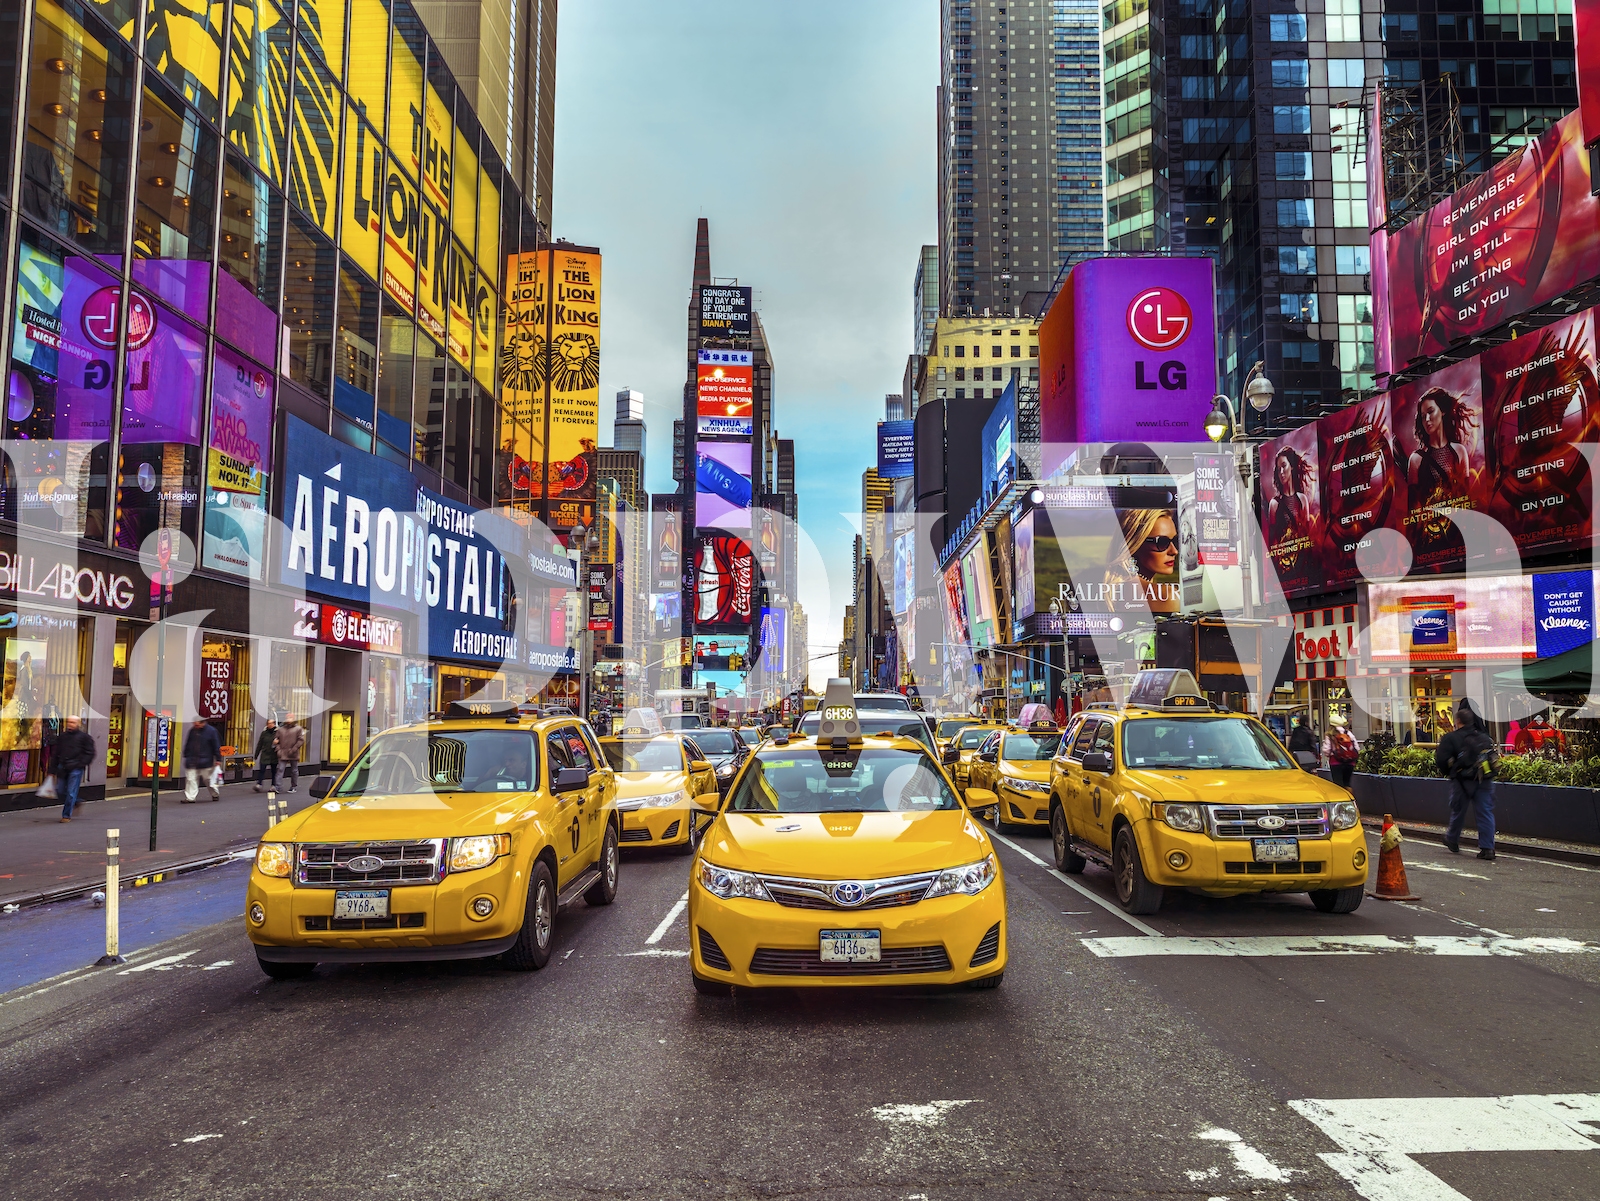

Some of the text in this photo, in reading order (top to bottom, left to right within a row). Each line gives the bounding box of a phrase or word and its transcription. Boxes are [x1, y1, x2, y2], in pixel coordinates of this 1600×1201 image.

[410, 101, 450, 200] THE
[354, 97, 430, 271] LION
[1442, 172, 1516, 228] REMEMBER
[1436, 193, 1526, 257] GIRL ON FIRE
[1451, 231, 1512, 274] I'M STILL
[432, 203, 490, 340] KING
[562, 270, 590, 282] THE
[1453, 257, 1513, 298] BETTING
[385, 272, 414, 308] ENTRANCE
[558, 283, 595, 302] LION
[702, 288, 741, 298] CONGRATS
[702, 296, 746, 306] ON DAY ONE
[702, 304, 734, 312] OF YOUR
[1457, 286, 1510, 322] ON YOU
[28, 310, 56, 330] Hosted
[555, 303, 599, 325] KING
[702, 319, 734, 328] DIANA P.
[32, 329, 93, 360] NICK CANNON
[1505, 349, 1566, 380] REMEMBER
[1135, 360, 1187, 391] LG
[576, 399, 598, 407] NOW.
[1502, 383, 1573, 414] GIRL ON FIRE
[554, 408, 595, 417] REMEMBER
[214, 404, 247, 440] HALO
[561, 417, 598, 426] FOREVER.
[709, 419, 741, 427] XINHUA
[1135, 420, 1189, 428] www.LG.com
[1333, 423, 1373, 444] REMEMBER
[1514, 423, 1563, 445] I'M STILL
[211, 424, 261, 463] AWARDS
[219, 455, 250, 476] SUNDA
[1332, 450, 1378, 472] GIRL ON FIRE
[1516, 457, 1566, 479] BETTING
[218, 470, 240, 486] NOV.
[1197, 467, 1219, 479] SOME
[1197, 479, 1224, 490] WALLS
[1340, 481, 1372, 498] I'M STILL
[1046, 490, 1104, 507] sunglass hut
[1197, 490, 1215, 501] CAN
[1521, 494, 1564, 513] ON YOU
[415, 485, 476, 539] AÉROPOSTALE
[560, 502, 580, 512] GET
[1197, 502, 1218, 513] TALK
[1403, 500, 1478, 526] CATCHING FIRE
[1411, 494, 1469, 515] THE HUNGER GAMES
[549, 510, 580, 519] TICKETS
[1341, 510, 1373, 525] BETTING
[1512, 523, 1578, 541] NOVEMBER 22
[1265, 540, 1315, 559] CATCHING FIRE
[1343, 539, 1372, 552] ON YOU
[1416, 546, 1457, 561] NOVEMBER
[0, 550, 135, 610] BILLABONG
[590, 571, 605, 579] SOME
[590, 578, 607, 586] WALLS
[1057, 582, 1180, 602] RALPH LAUR
[1543, 591, 1584, 600] DON'T GET
[1547, 606, 1582, 614] WITHOUT
[1548, 599, 1580, 607] CAUGHT
[1413, 616, 1446, 627] Kleenex
[1467, 623, 1493, 632] Kleenex
[1539, 615, 1588, 631] Kleenex
[347, 616, 395, 648] ELEMENT
[452, 624, 518, 661] AÉROPOSTALE
[1295, 628, 1342, 662] Foot
[206, 661, 230, 679] TEES
[210, 679, 215, 689] 3
[216, 680, 224, 689] for
[204, 689, 229, 714] $33
[469, 703, 492, 715] 9Y68
[1174, 696, 1195, 706] 6P76
[825, 707, 854, 720] 6H36
[347, 899, 376, 913] 9Y68A
[834, 939, 867, 955] 6H36D
